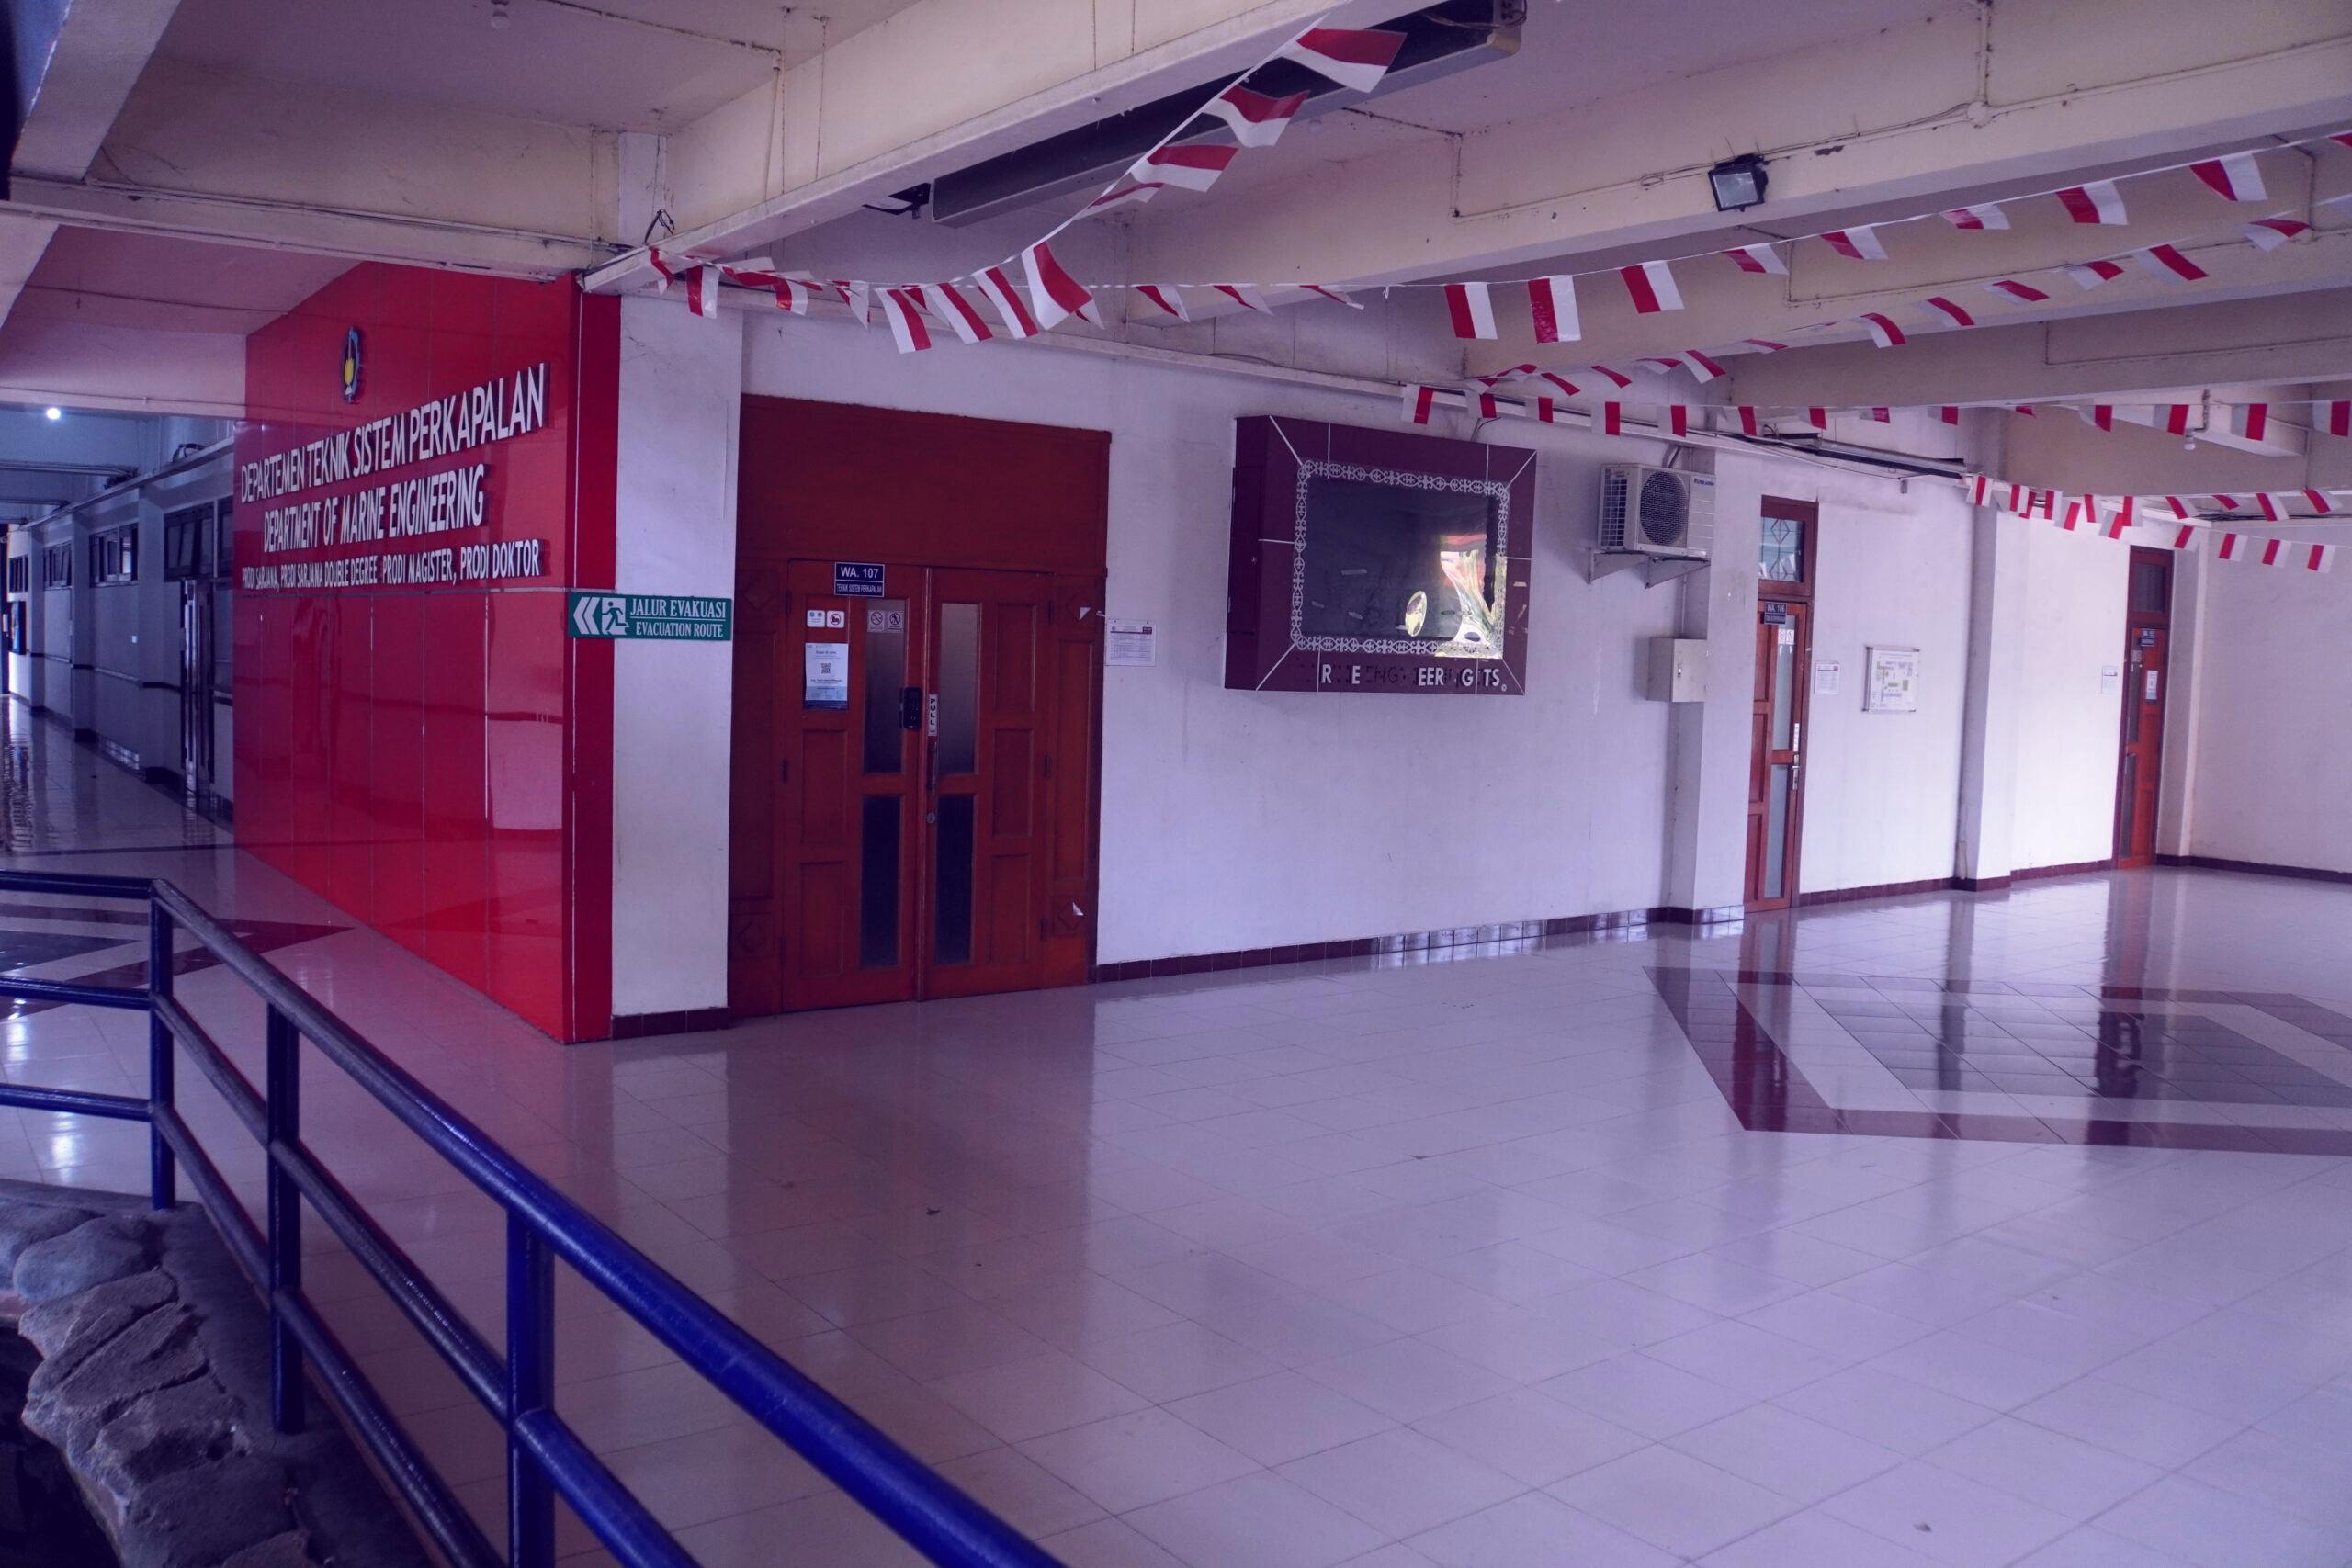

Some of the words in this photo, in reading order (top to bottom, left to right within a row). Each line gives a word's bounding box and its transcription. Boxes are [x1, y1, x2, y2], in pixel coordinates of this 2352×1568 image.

[241, 446, 305, 503] DEPARTEMEN
[307, 431, 350, 488] TEKNIK
[354, 413, 405, 477] SISTEM
[410, 363, 545, 462] PERKAPALAN
[264, 502, 322, 552] DEPARTMENT
[323, 497, 339, 546] OF
[340, 486, 386, 545] MARINE
[389, 463, 485, 538] ENGINEERING
[280, 564, 296, 589] PRODI
[297, 562, 322, 588] SARJANA
[324, 559, 349, 587] DOUBLE
[350, 556, 378, 586] DEGREE
[382, 554, 406, 585] PRODI
[408, 548, 457, 586] MAGISTER,
[460, 544, 490, 581] PRODI
[492, 538, 540, 579] DOKTOR
[841, 566, 860, 578] WA.
[863, 568, 879, 579] 107
[630, 598, 668, 617] JALUR
[670, 599, 726, 619] EVAKUASI
[636, 621, 692, 637] EVACUATION
[694, 624, 724, 637] ROUTE
